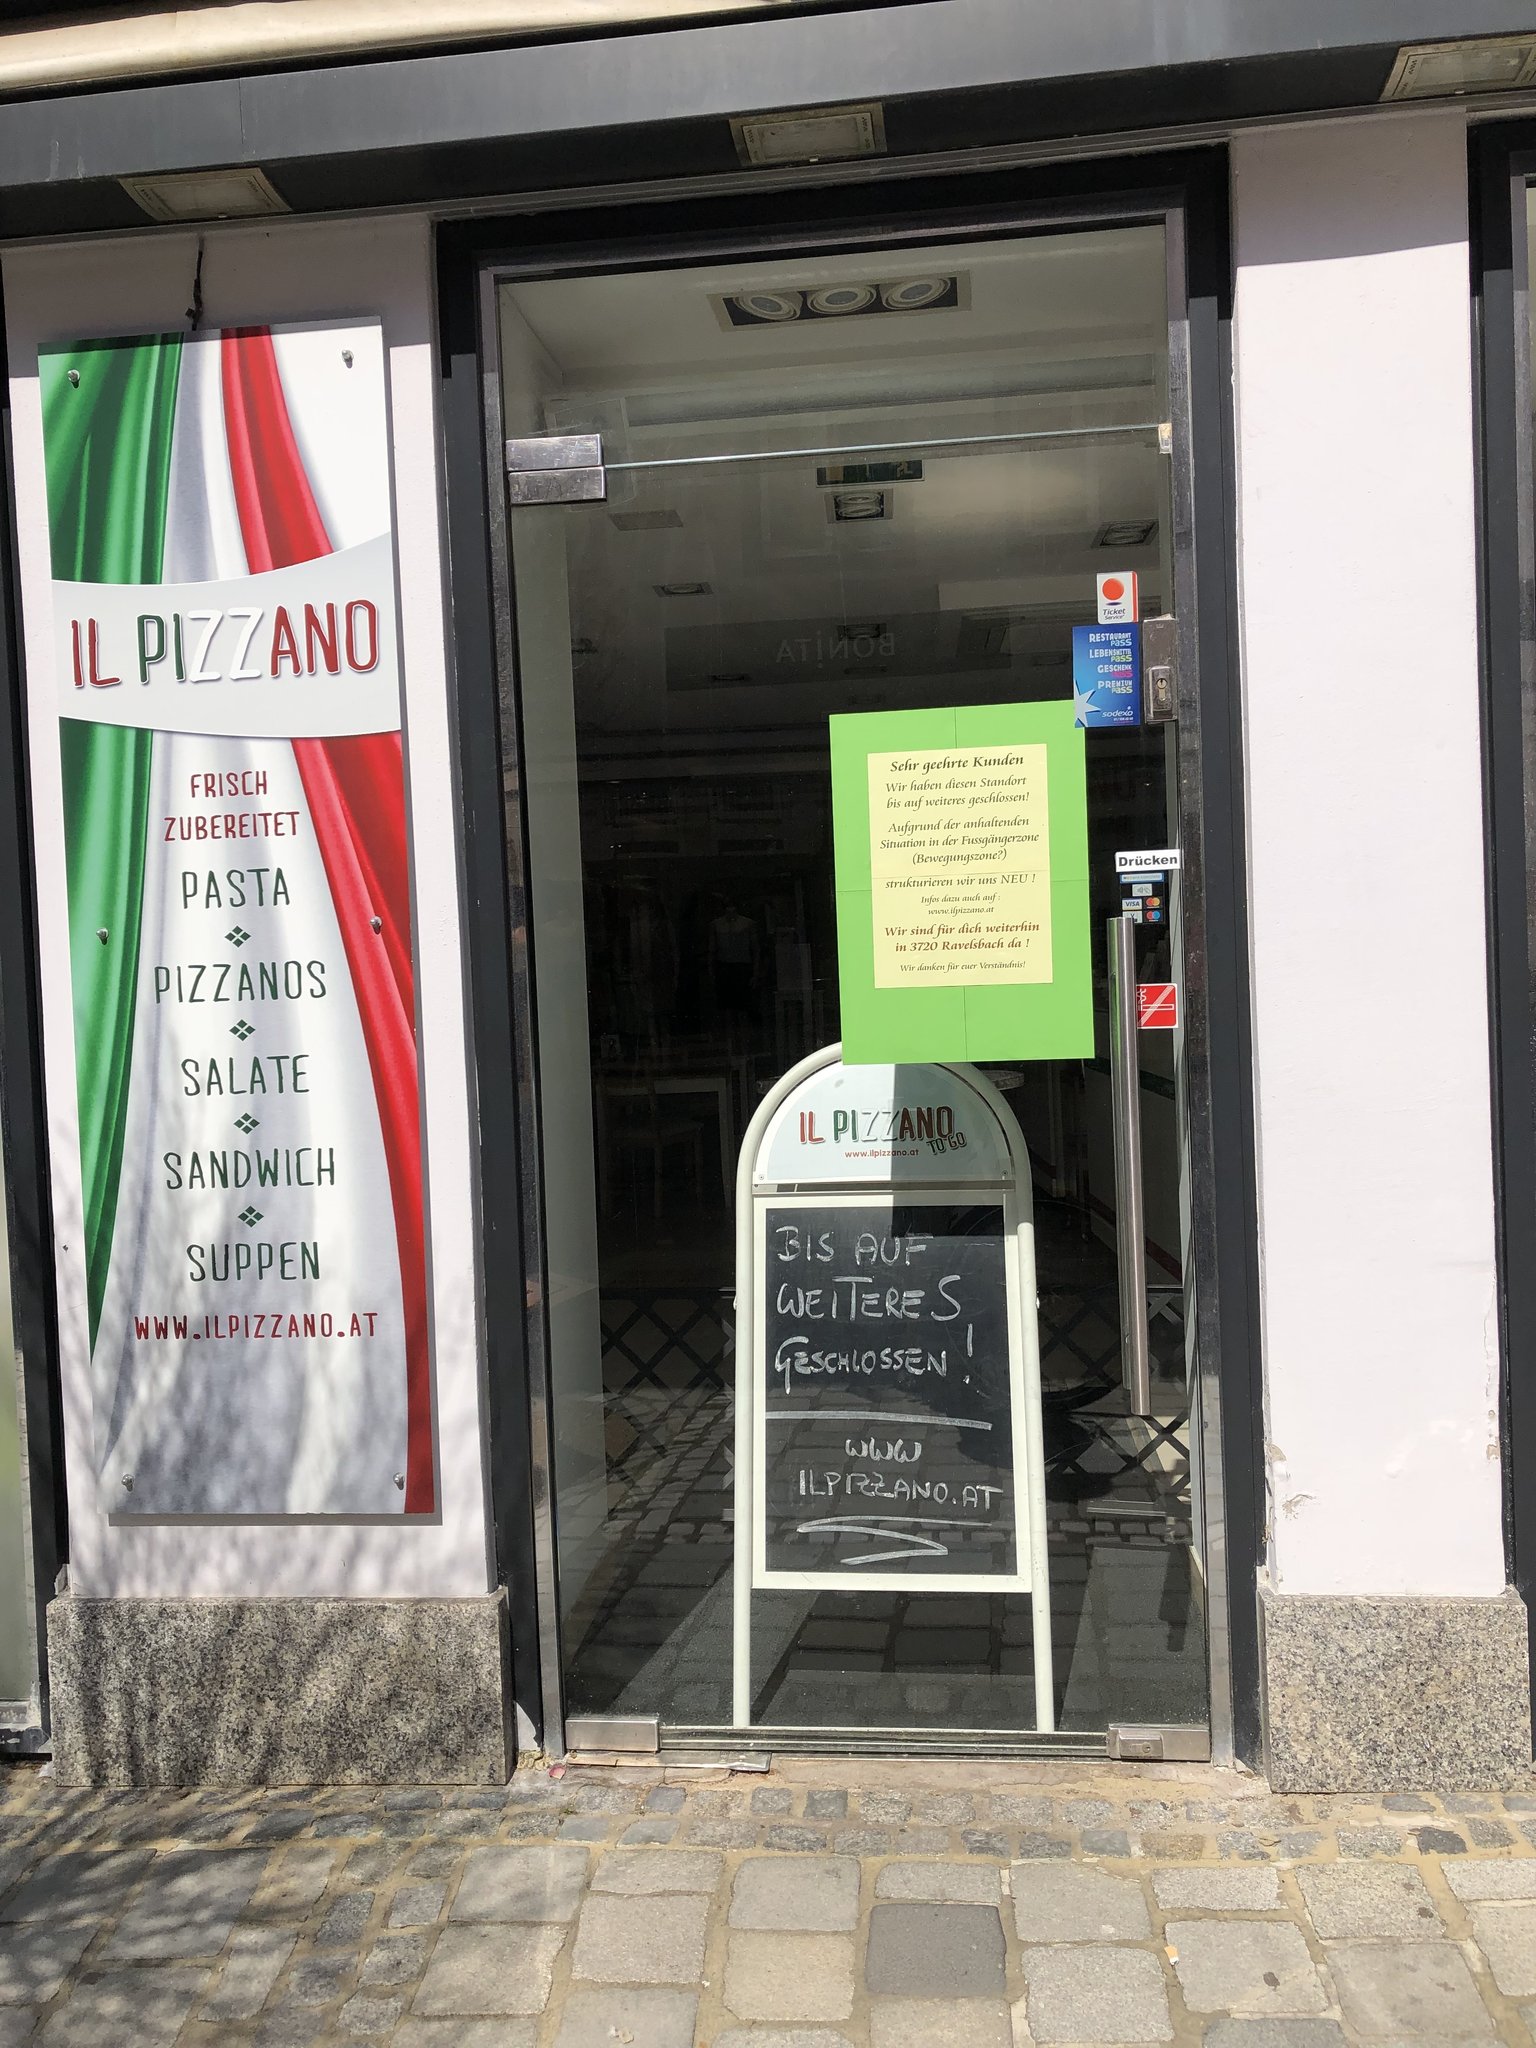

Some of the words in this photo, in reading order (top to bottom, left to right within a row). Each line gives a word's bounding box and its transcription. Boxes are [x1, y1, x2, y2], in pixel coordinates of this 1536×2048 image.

[70, 617, 122, 690] IL
[136, 599, 380, 685] PIZZANO
[1089, 632, 1132, 643] RESTAURANT
[1097, 664, 1132, 673] GESCHENK
[1097, 680, 1133, 689] PREMIUM
[1102, 708, 1134, 718] sodexo
[890, 758, 919, 772] Sehr
[922, 756, 968, 775] geehrte
[973, 753, 1024, 768] Kunden
[190, 769, 269, 799] FRISCH
[886, 781, 907, 792] Wir
[910, 779, 942, 792] haben
[945, 777, 977, 789] diesen
[980, 775, 1027, 787] Standort
[886, 797, 901, 809] bis
[904, 796, 923, 811] auf
[926, 796, 966, 806] weiteres
[968, 792, 1030, 808] geschlossen!
[163, 811, 300, 843] ZUBEREITET
[888, 819, 943, 836] Aufgrund
[944, 819, 961, 831] der
[963, 815, 1030, 829] anhaltenden
[880, 838, 926, 849] Situation
[929, 838, 939, 847] in
[942, 835, 959, 846] der
[961, 833, 1040, 848] Fussgängerzone
[912, 849, 1007, 866] (Bewegungszone?)
[1118, 855, 1178, 867] Drücken
[182, 867, 291, 910] PASTA
[885, 876, 953, 888] strukturieren
[957, 876, 976, 886] wir
[978, 876, 997, 885] uns
[1000, 874, 1028, 885] NEU
[921, 894, 940, 906] Infos
[941, 894, 960, 903] dazu
[962, 893, 981, 903] auch
[983, 892, 997, 905] auf
[928, 906, 995, 917] www.ilpizzano.at
[885, 926, 908, 937] Wir
[910, 924, 934, 936] sind
[933, 923, 955, 938] für
[958, 922, 982, 934] dich
[985, 921, 1040, 933] weiterhin
[895, 942, 907, 952] in
[909, 941, 939, 952] 3720
[942, 938, 1004, 951] Ravelsbach
[1007, 937, 1022, 948] da
[900, 964, 915, 972] Wir
[917, 962, 945, 972] danken
[945, 962, 960, 974] für
[961, 962, 978, 971] euer
[979, 961, 1026, 970] Verständnis!
[153, 960, 328, 1005] PIZZANOS
[181, 1053, 311, 1098] SALATE
[800, 1111, 825, 1144] IL
[833, 1106, 955, 1143] PIZZANO
[845, 1149, 919, 1158] www.ilpizzano.at
[926, 1139, 945, 1155] TO
[949, 1132, 967, 1149] GO
[163, 1145, 337, 1192] SANDWICH
[775, 1226, 835, 1262] BIS
[854, 1231, 934, 1266] AUF
[186, 1241, 322, 1283] SUPPEN
[775, 1275, 963, 1320] WEITERES
[133, 1312, 379, 1341] WWW.ILPIZZANO.AT
[799, 1469, 1004, 1510] ILPIZZANO.AT
